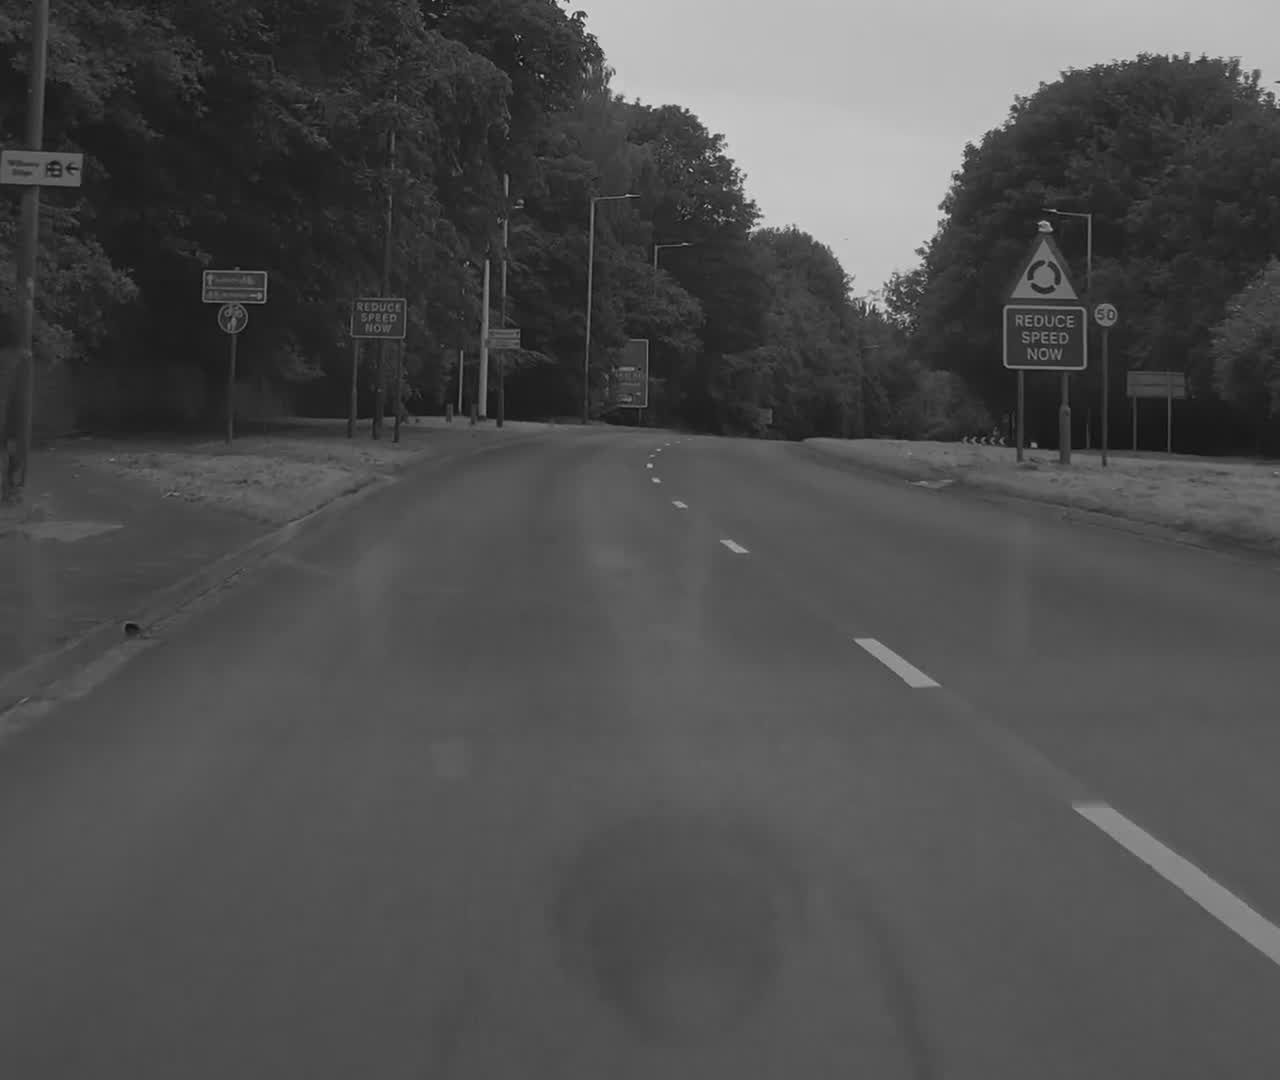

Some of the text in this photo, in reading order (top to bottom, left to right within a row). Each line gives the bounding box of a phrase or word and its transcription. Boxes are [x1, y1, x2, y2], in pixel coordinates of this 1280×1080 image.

[357, 302, 401, 313] REDUCE
[361, 313, 397, 323] SPEED
[1097, 309, 1115, 320] 50
[1015, 314, 1075, 328] REDUCE
[365, 323, 392, 333] NOW
[1022, 331, 1069, 344] SPEED
[1027, 348, 1063, 360] NOW
